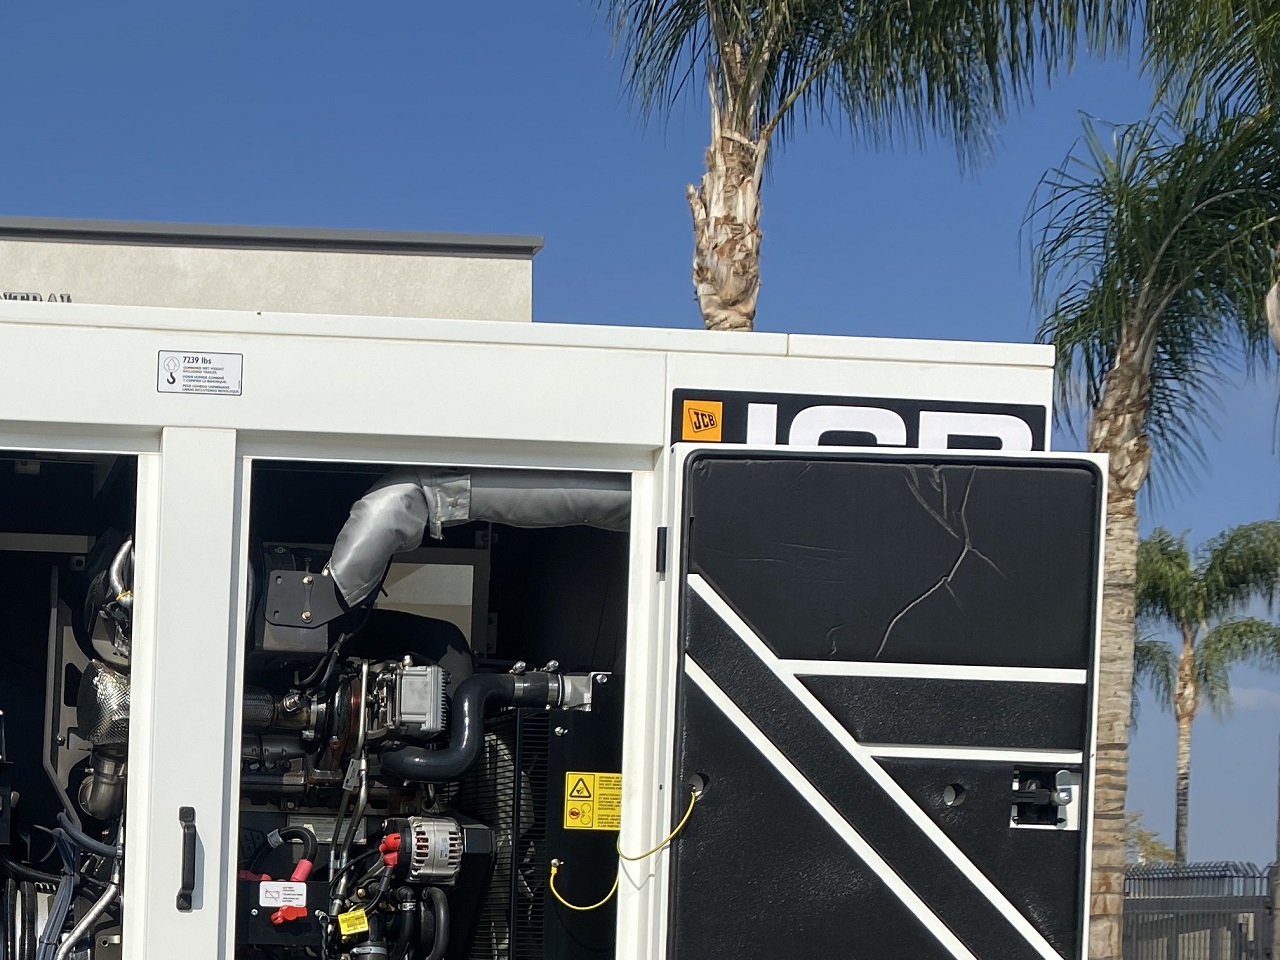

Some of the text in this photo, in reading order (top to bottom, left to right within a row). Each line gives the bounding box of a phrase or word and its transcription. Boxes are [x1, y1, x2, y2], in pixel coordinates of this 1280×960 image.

[182, 356, 212, 365] 7239 lbs
[693, 409, 716, 430] JCB
